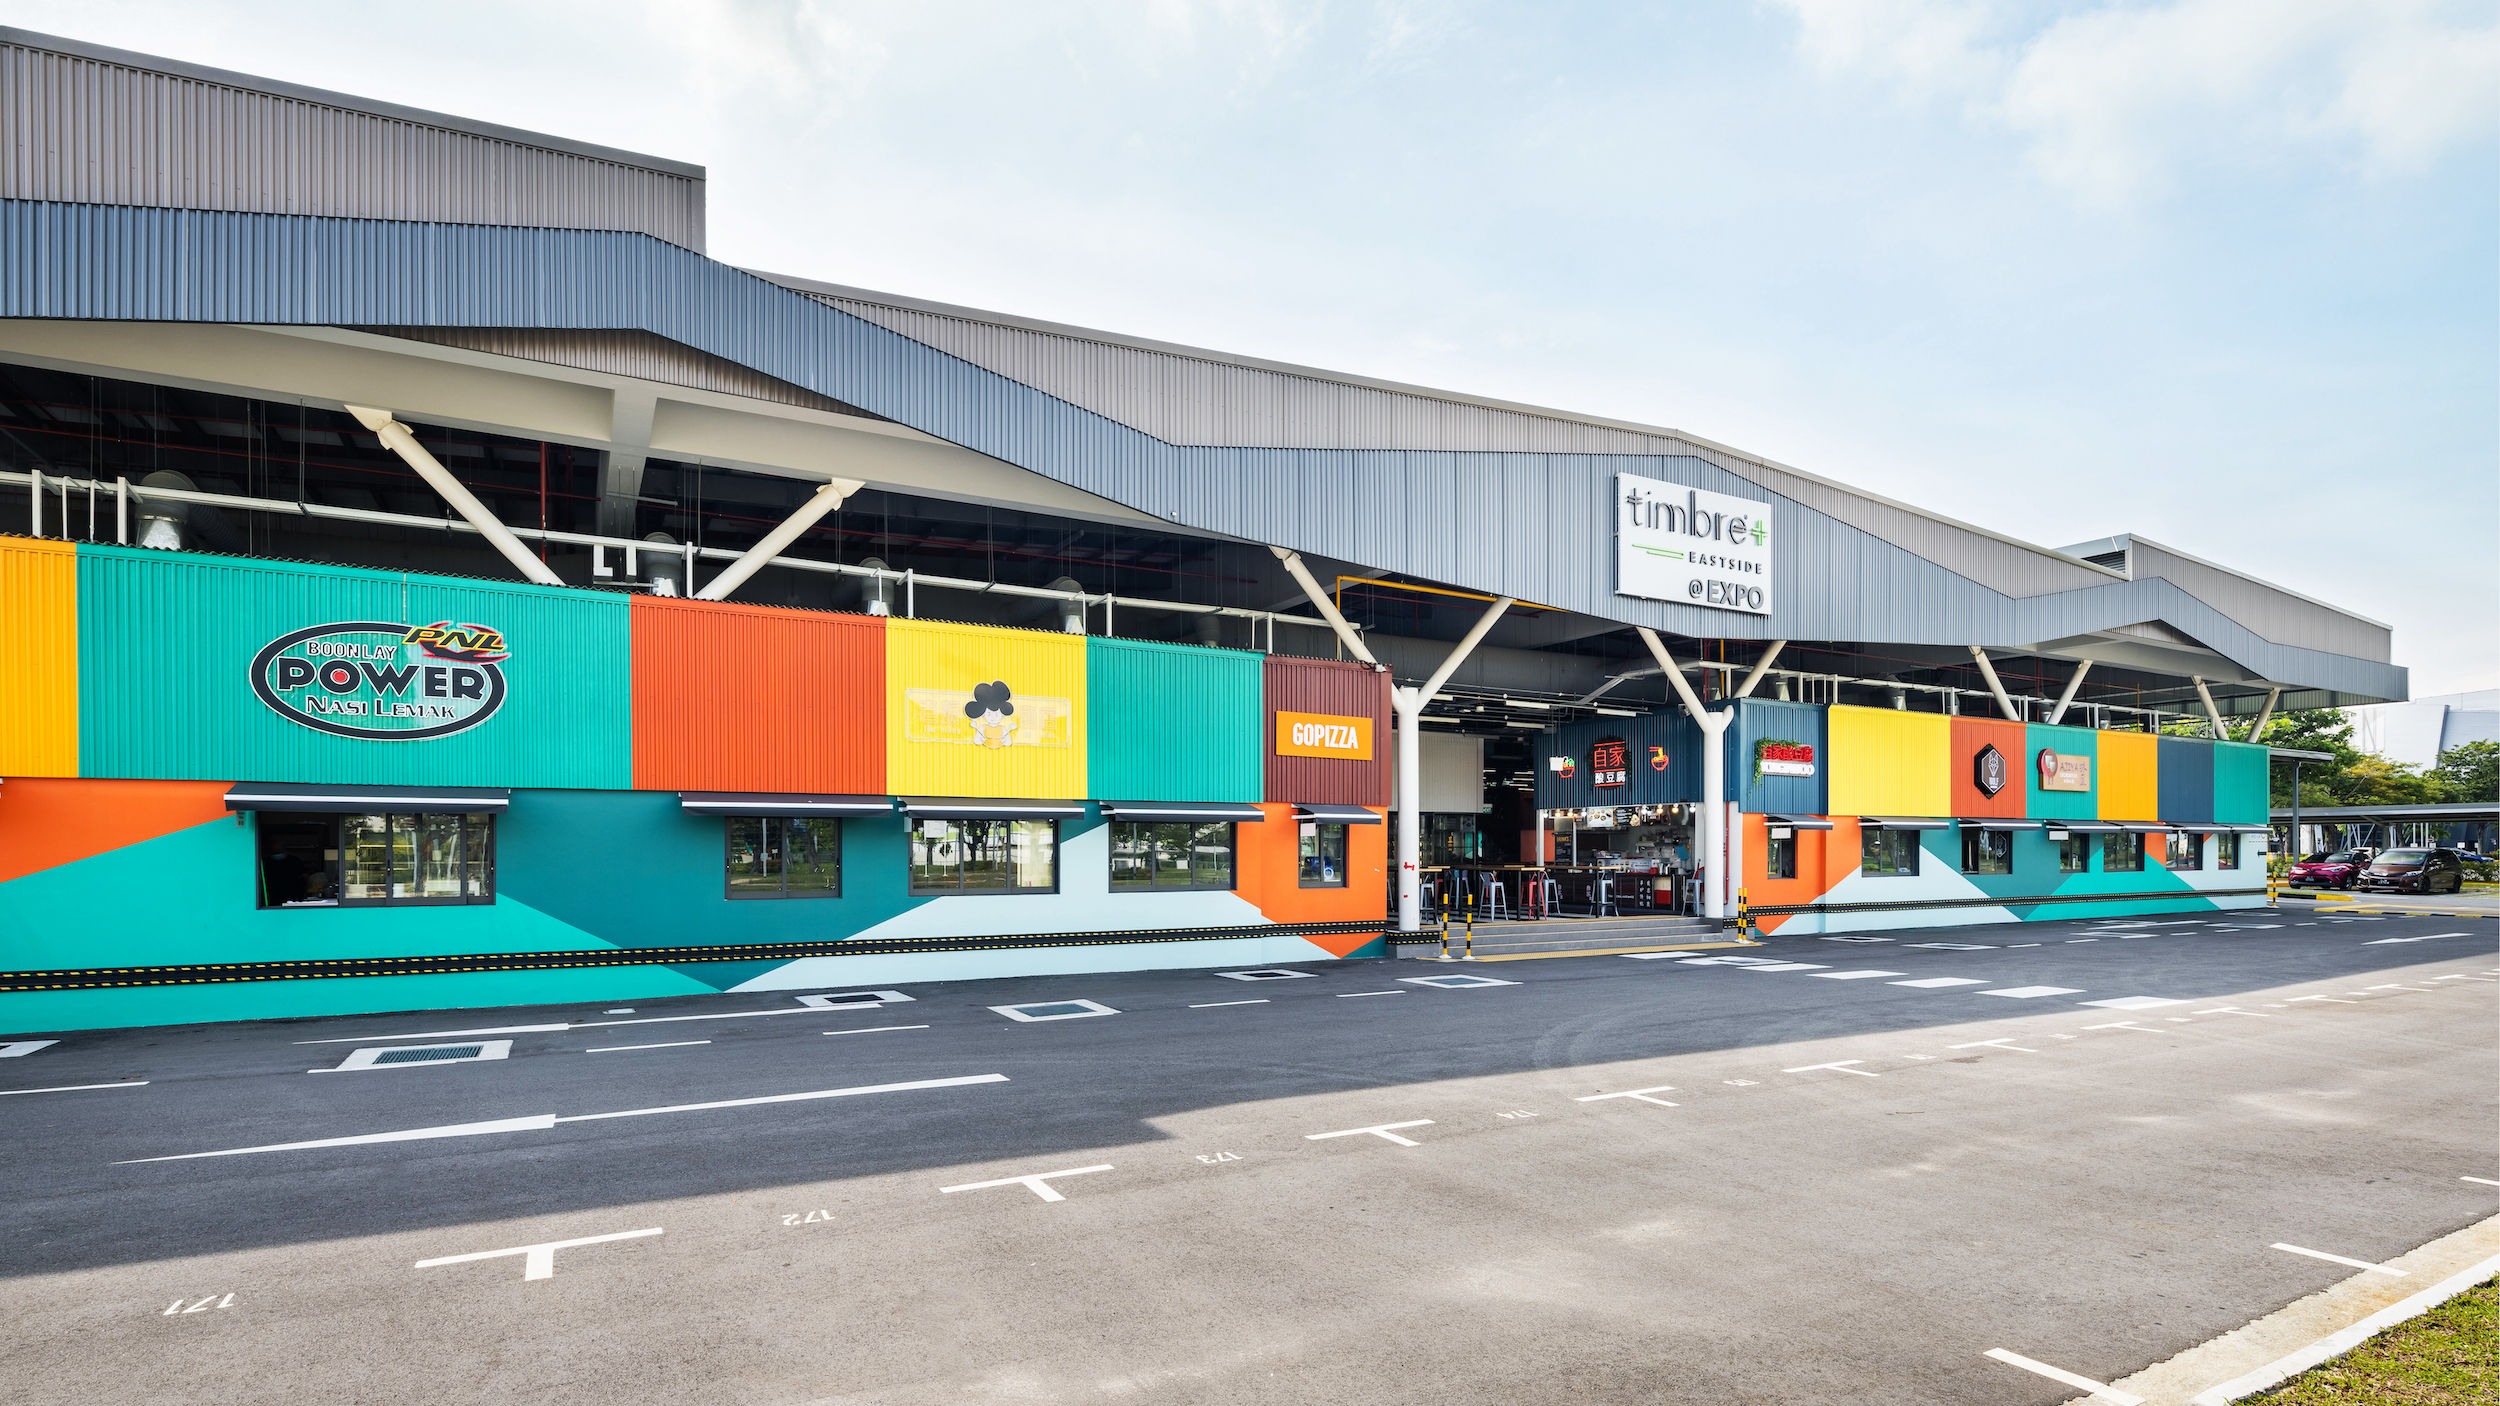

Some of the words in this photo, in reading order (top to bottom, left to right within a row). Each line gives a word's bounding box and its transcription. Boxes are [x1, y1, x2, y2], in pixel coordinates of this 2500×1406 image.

[1689, 551, 1763, 575] EASTSIDE
[402, 627, 505, 651] PNL
[277, 657, 486, 700] POWER
[1292, 722, 1359, 750] GOPIZZA
[1594, 746, 1625, 768] 自家
[1195, 1151, 1244, 1164] 173
[781, 1209, 836, 1226] 172
[163, 1292, 235, 1316] 171
